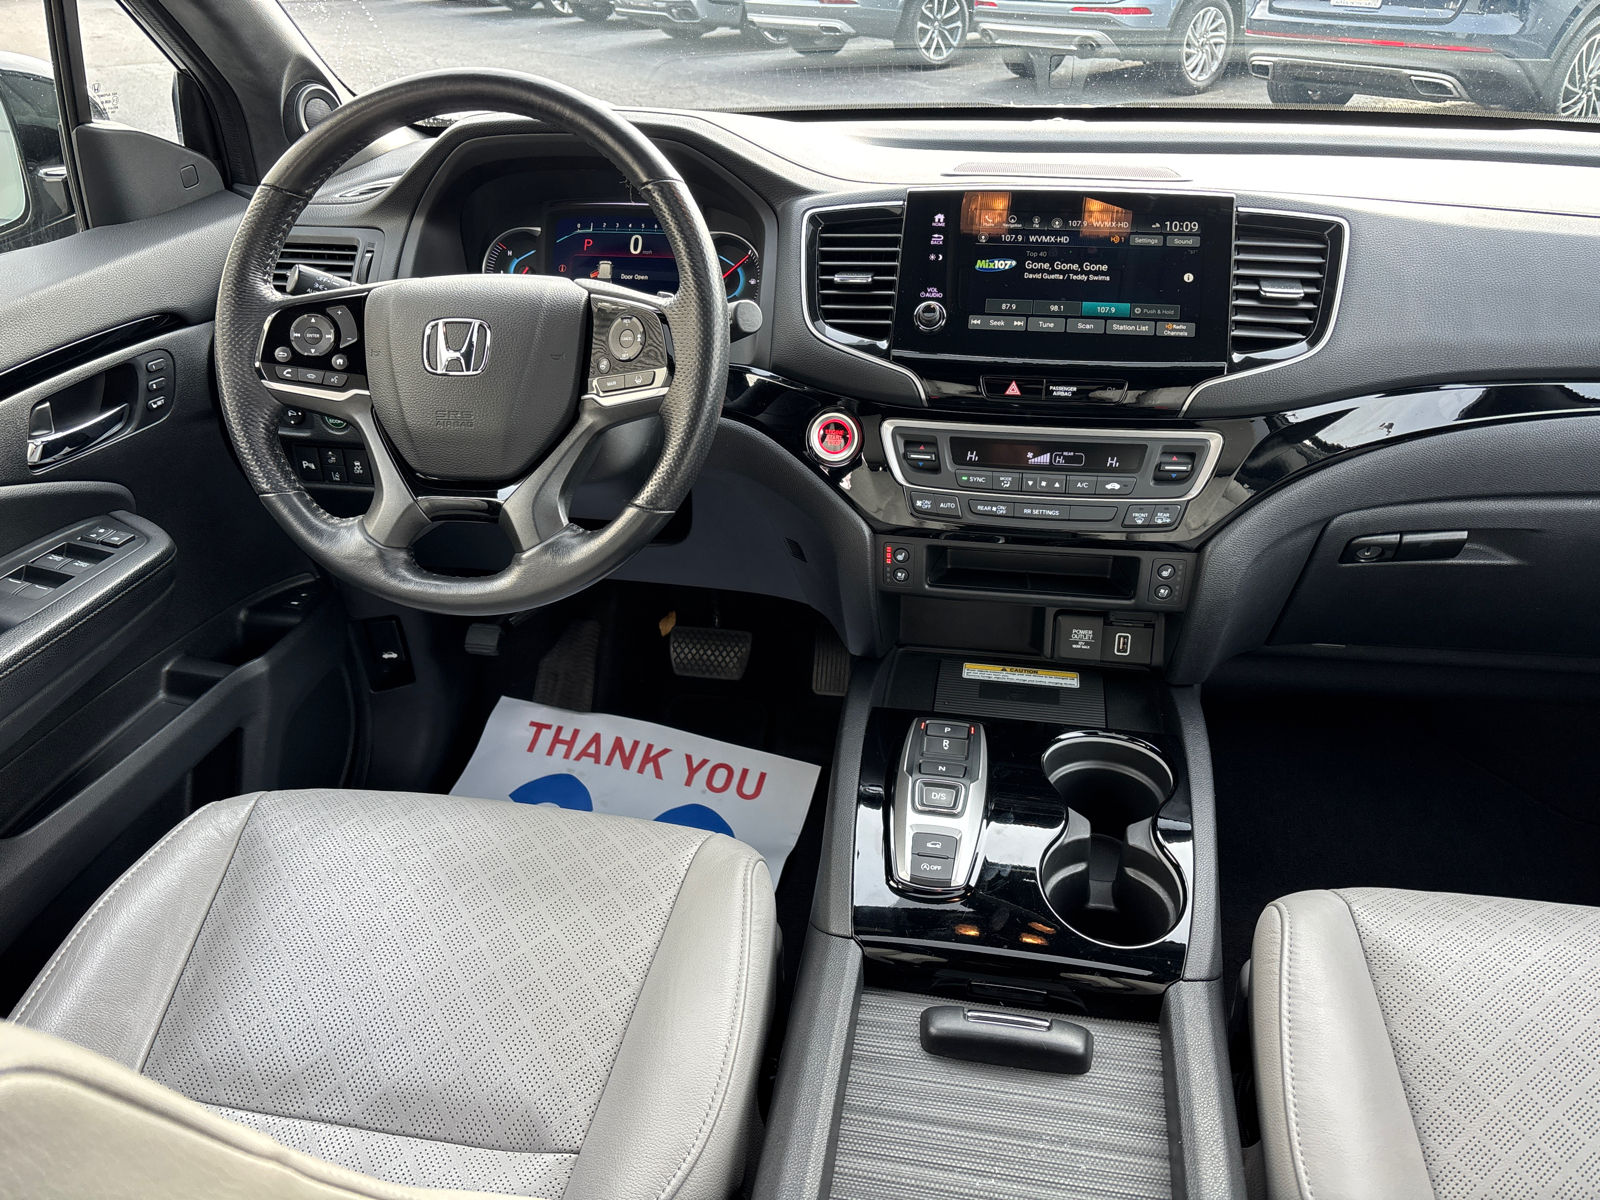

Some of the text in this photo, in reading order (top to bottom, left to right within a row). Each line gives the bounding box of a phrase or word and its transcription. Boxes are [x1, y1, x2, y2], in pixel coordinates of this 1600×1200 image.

[1164, 221, 1199, 232] 10:09
[584, 239, 593, 251] P
[630, 235, 642, 254] 0
[1025, 260, 1108, 271] Gone, Gone, Gone
[526, 720, 767, 800] THANK YOU
[931, 792, 946, 800] D/S
